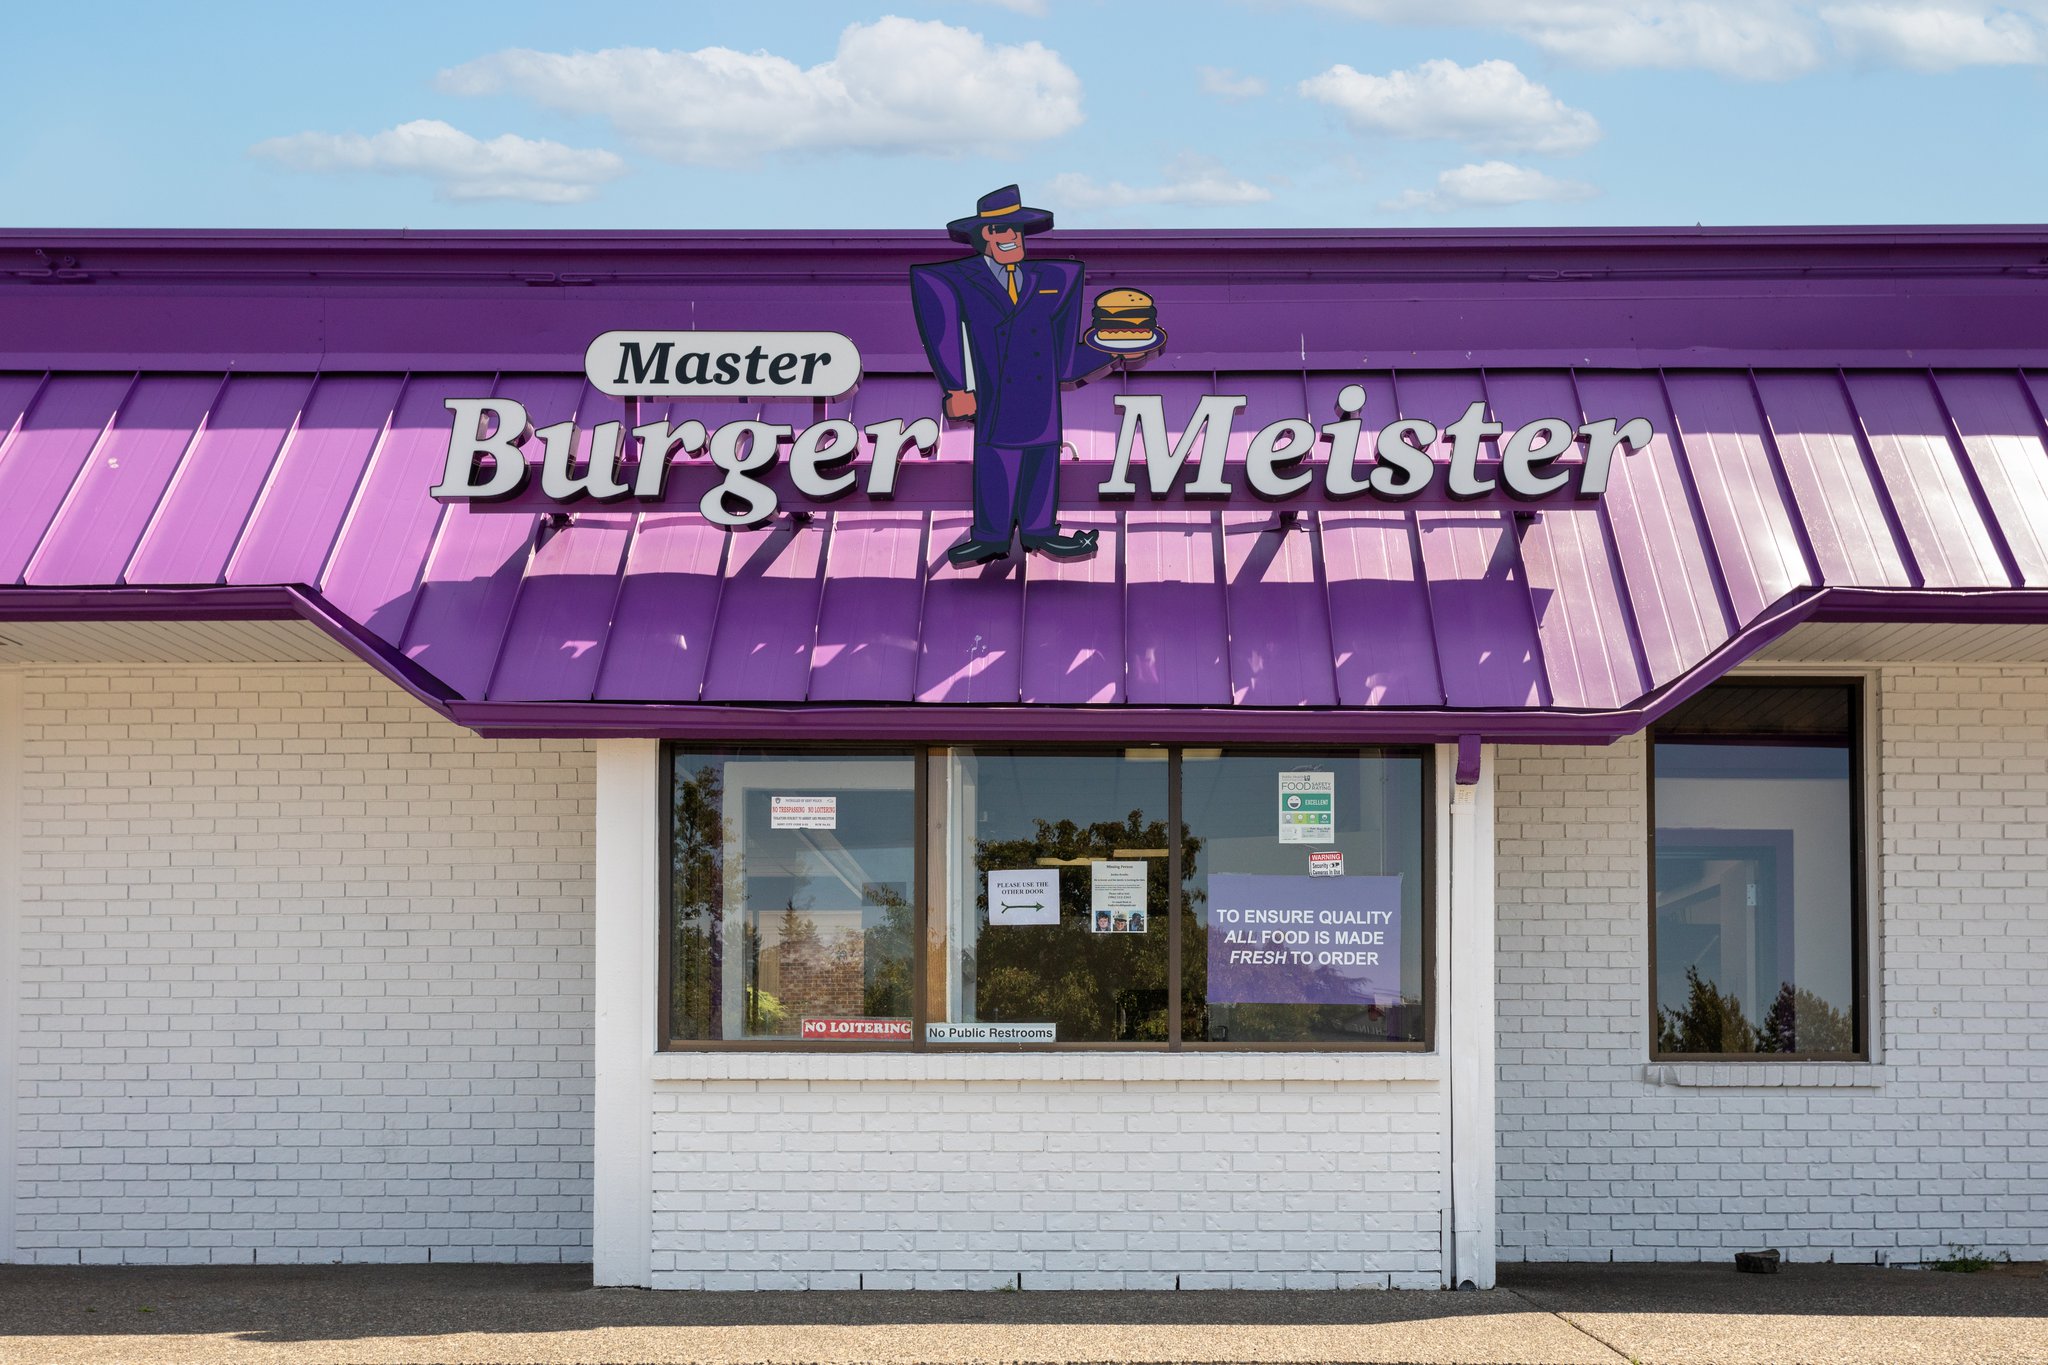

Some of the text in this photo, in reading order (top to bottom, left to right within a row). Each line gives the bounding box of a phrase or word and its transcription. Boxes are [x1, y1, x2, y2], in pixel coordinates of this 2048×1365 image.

[613, 342, 831, 385] Master
[430, 384, 1654, 528] Burger Meister
[1282, 782, 1311, 790] FOOD
[1216, 909, 1392, 925] TO ENSURE QUALITY
[1224, 930, 1384, 945] ALL FOOD IS MADE
[1230, 950, 1379, 966] FRESH TO ORDER
[804, 1022, 911, 1034] NO LOITERING
[929, 1028, 1053, 1038] No Public Restrooms
